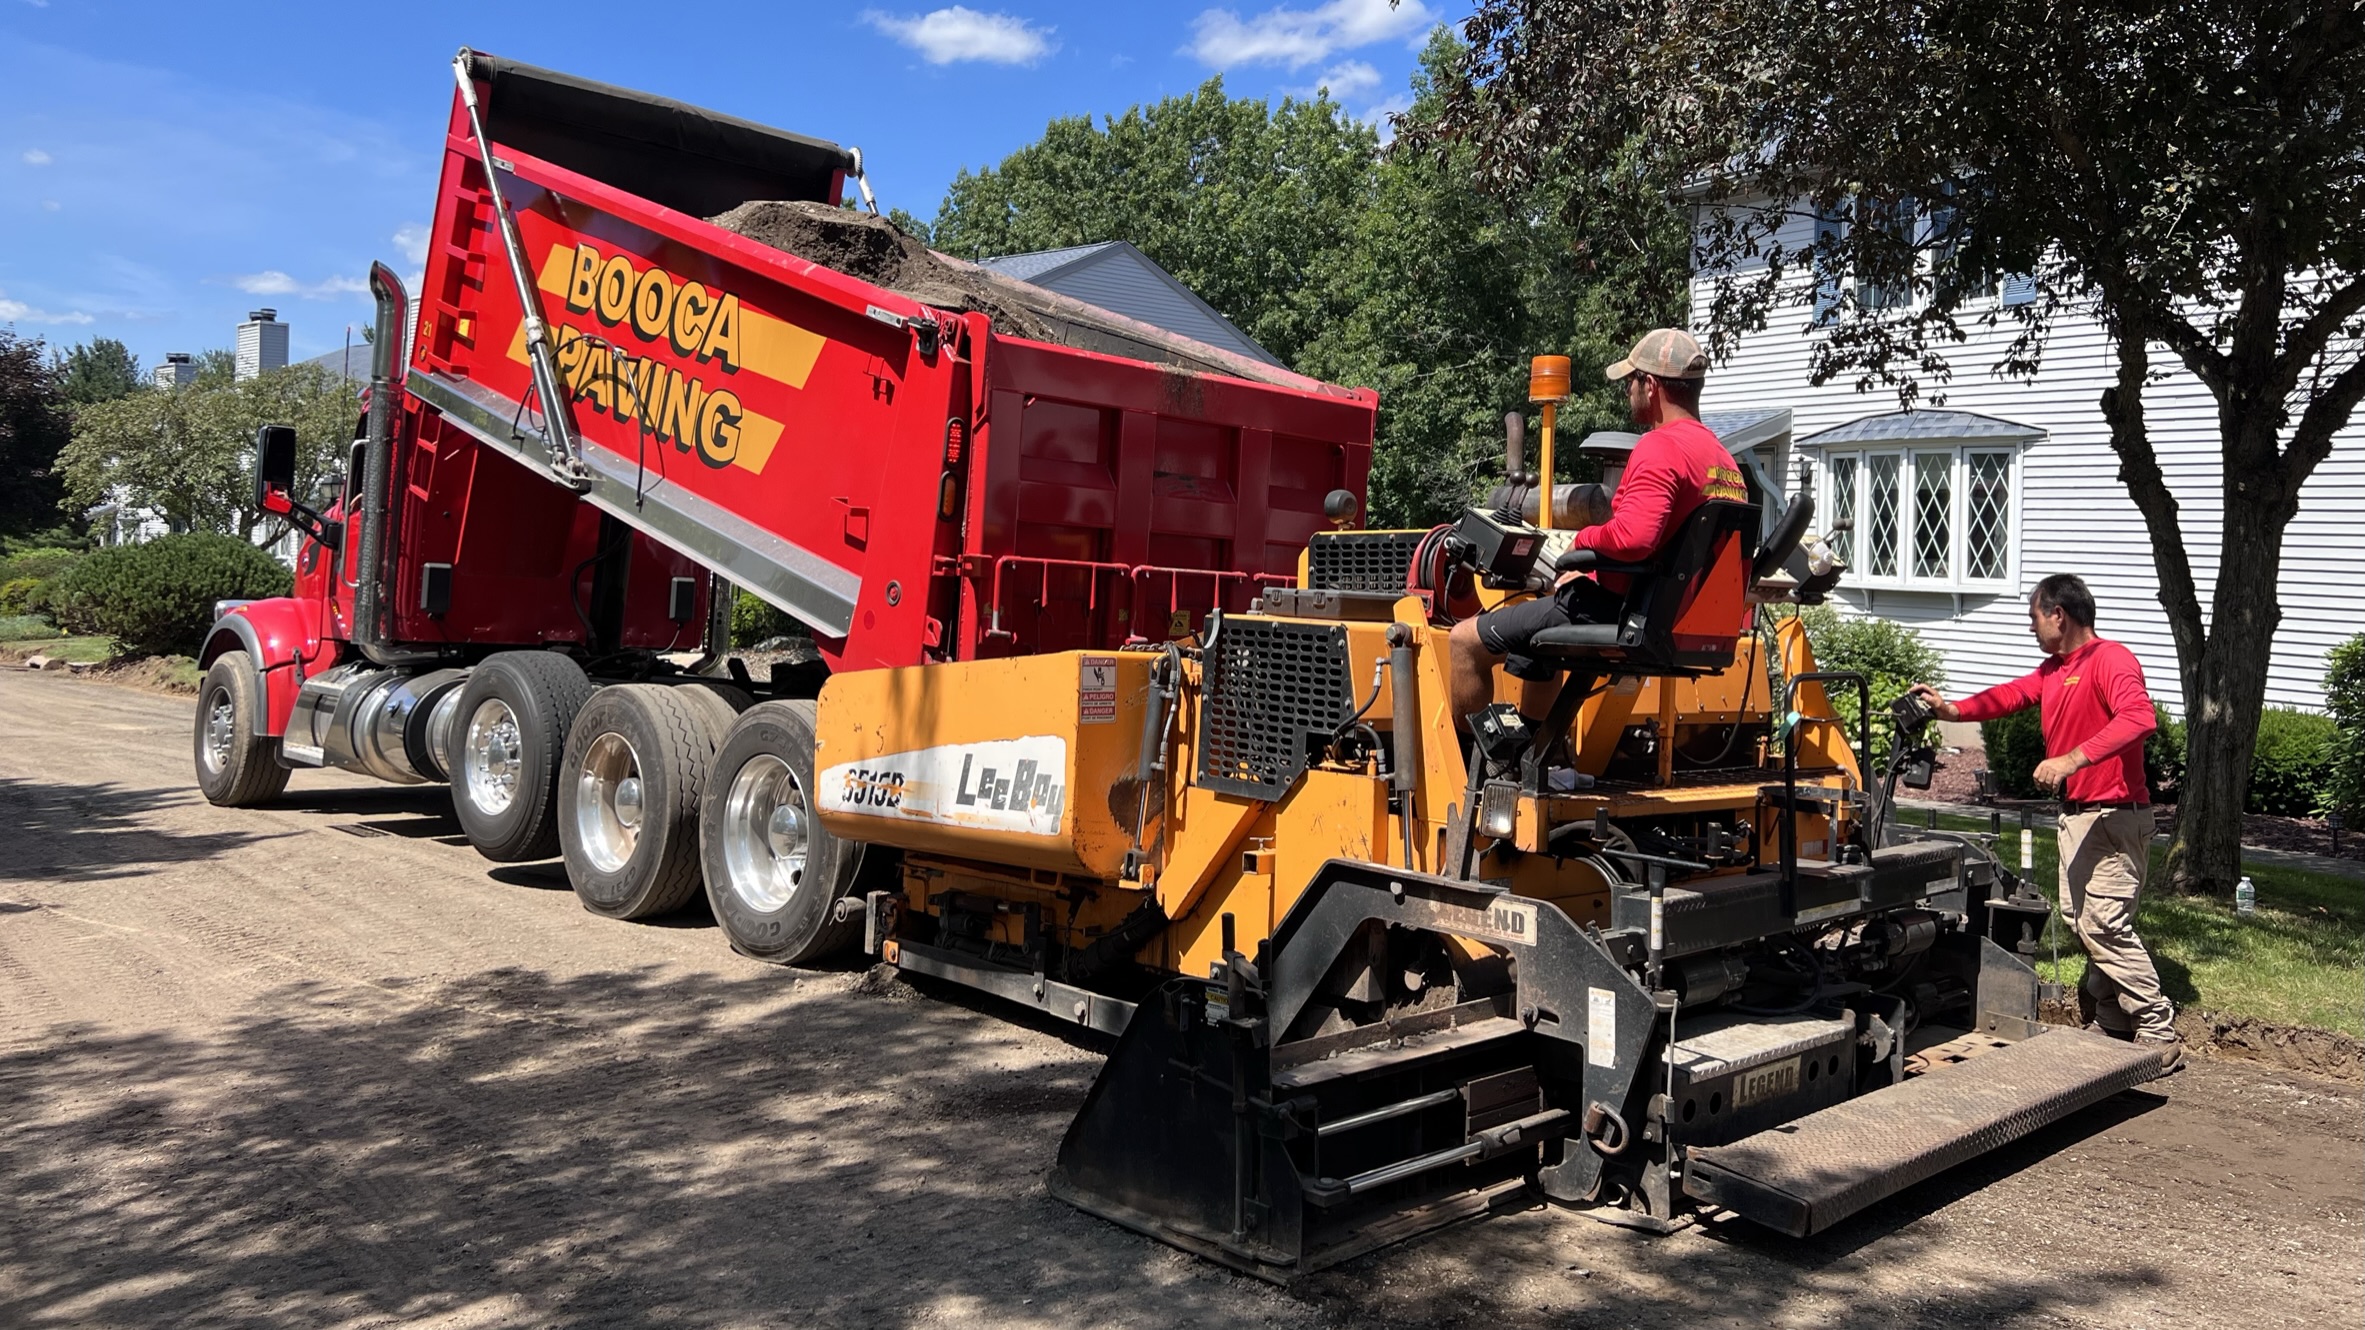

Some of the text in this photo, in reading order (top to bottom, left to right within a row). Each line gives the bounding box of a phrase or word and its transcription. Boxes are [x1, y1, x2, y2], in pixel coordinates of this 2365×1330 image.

[566, 242, 741, 376] BOOCA
[423, 320, 433, 338] 21
[552, 323, 743, 470] PAVING
[1089, 693, 1114, 701] PELIGRO
[1089, 707, 1113, 715] DANGER
[1739, 1066, 1795, 1104] LEGEND
